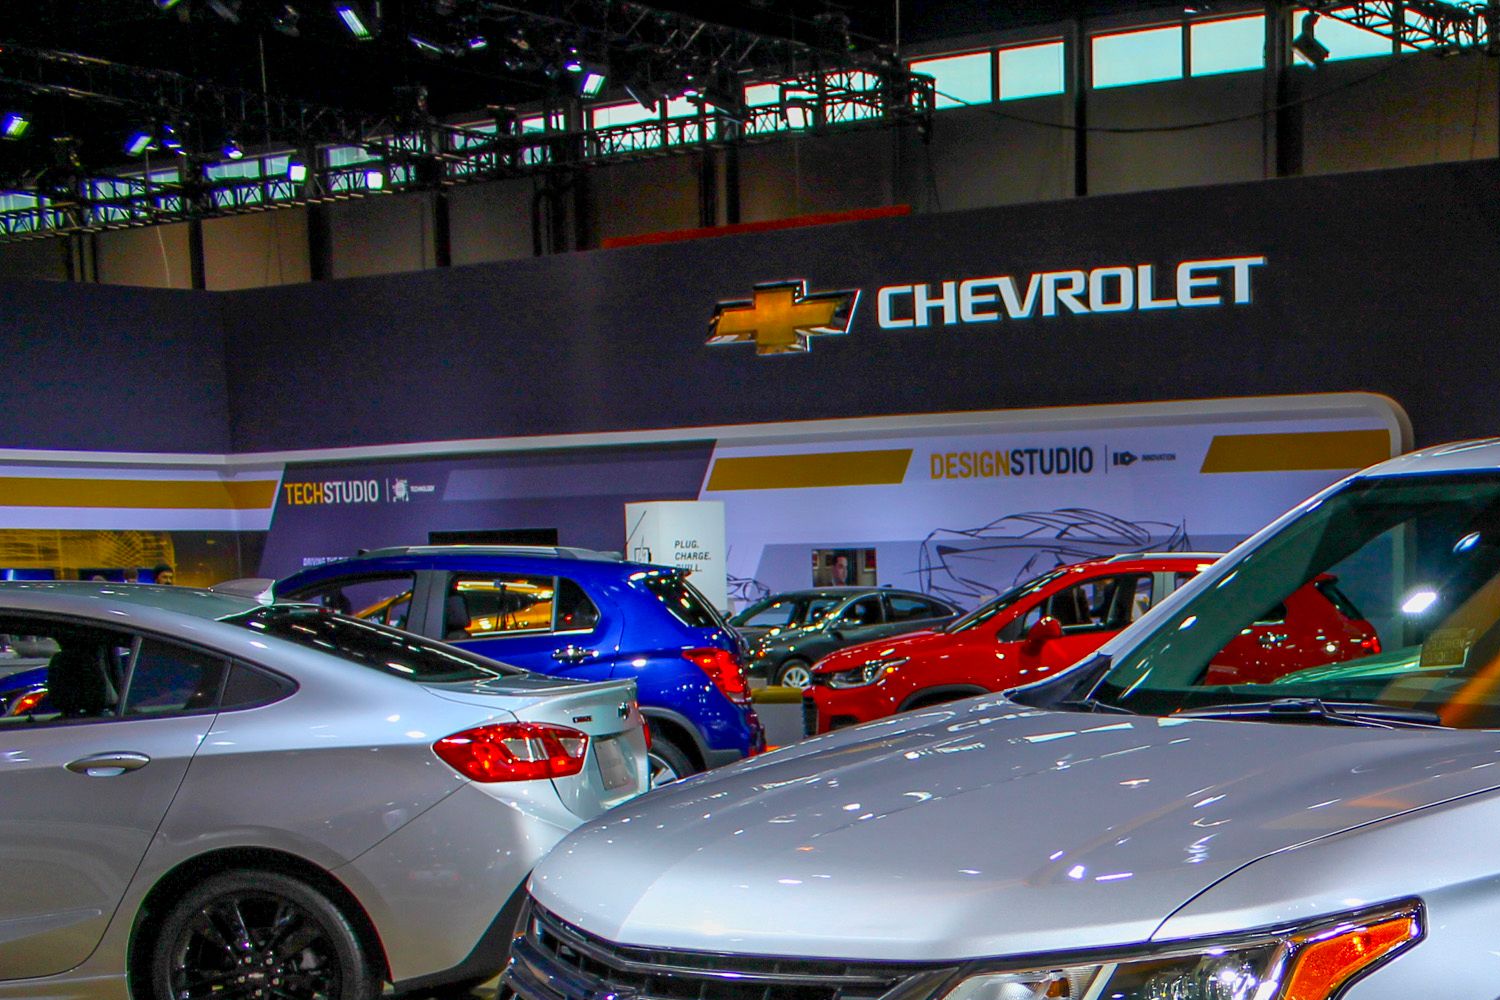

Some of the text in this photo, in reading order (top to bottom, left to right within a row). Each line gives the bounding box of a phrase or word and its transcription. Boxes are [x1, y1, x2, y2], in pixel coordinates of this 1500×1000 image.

[877, 256, 1267, 329] CHEVROLET
[674, 540, 700, 549] PLUG.
[674, 551, 712, 560] CHARGE.
